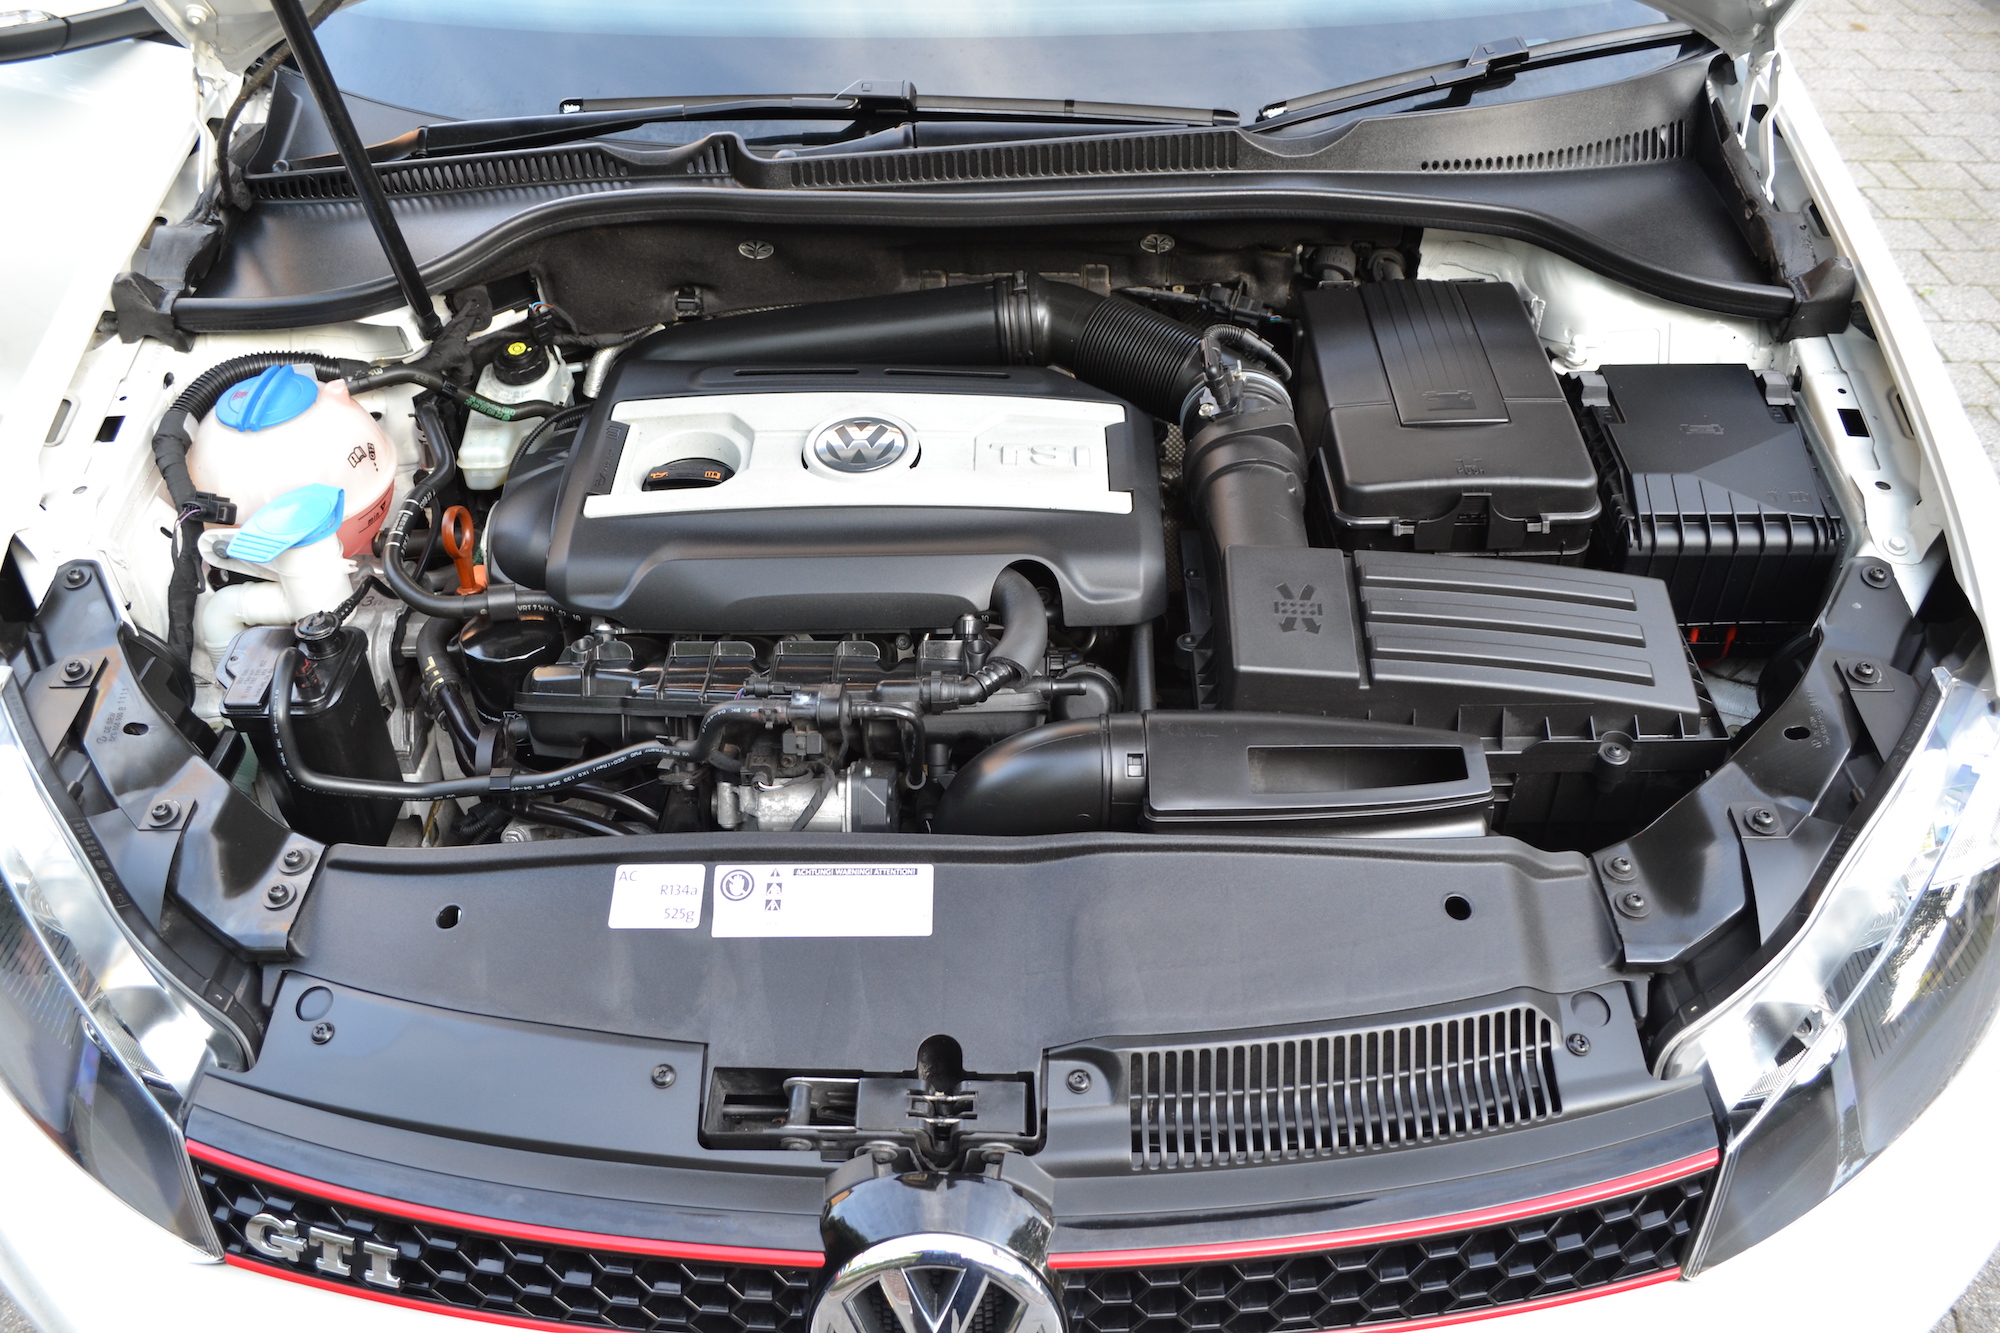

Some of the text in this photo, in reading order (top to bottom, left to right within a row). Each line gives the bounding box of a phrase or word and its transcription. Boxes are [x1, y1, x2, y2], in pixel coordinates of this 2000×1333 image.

[988, 442, 1091, 468] TSI
[1456, 466, 1485, 475] PUSH
[368, 512, 380, 526] min
[618, 870, 638, 881] AC
[795, 868, 916, 876] ACHTUNG! WARNING! ATTENTION!
[660, 884, 698, 896] R134a
[664, 907, 695, 923] 525g
[245, 1212, 400, 1288] GTI
